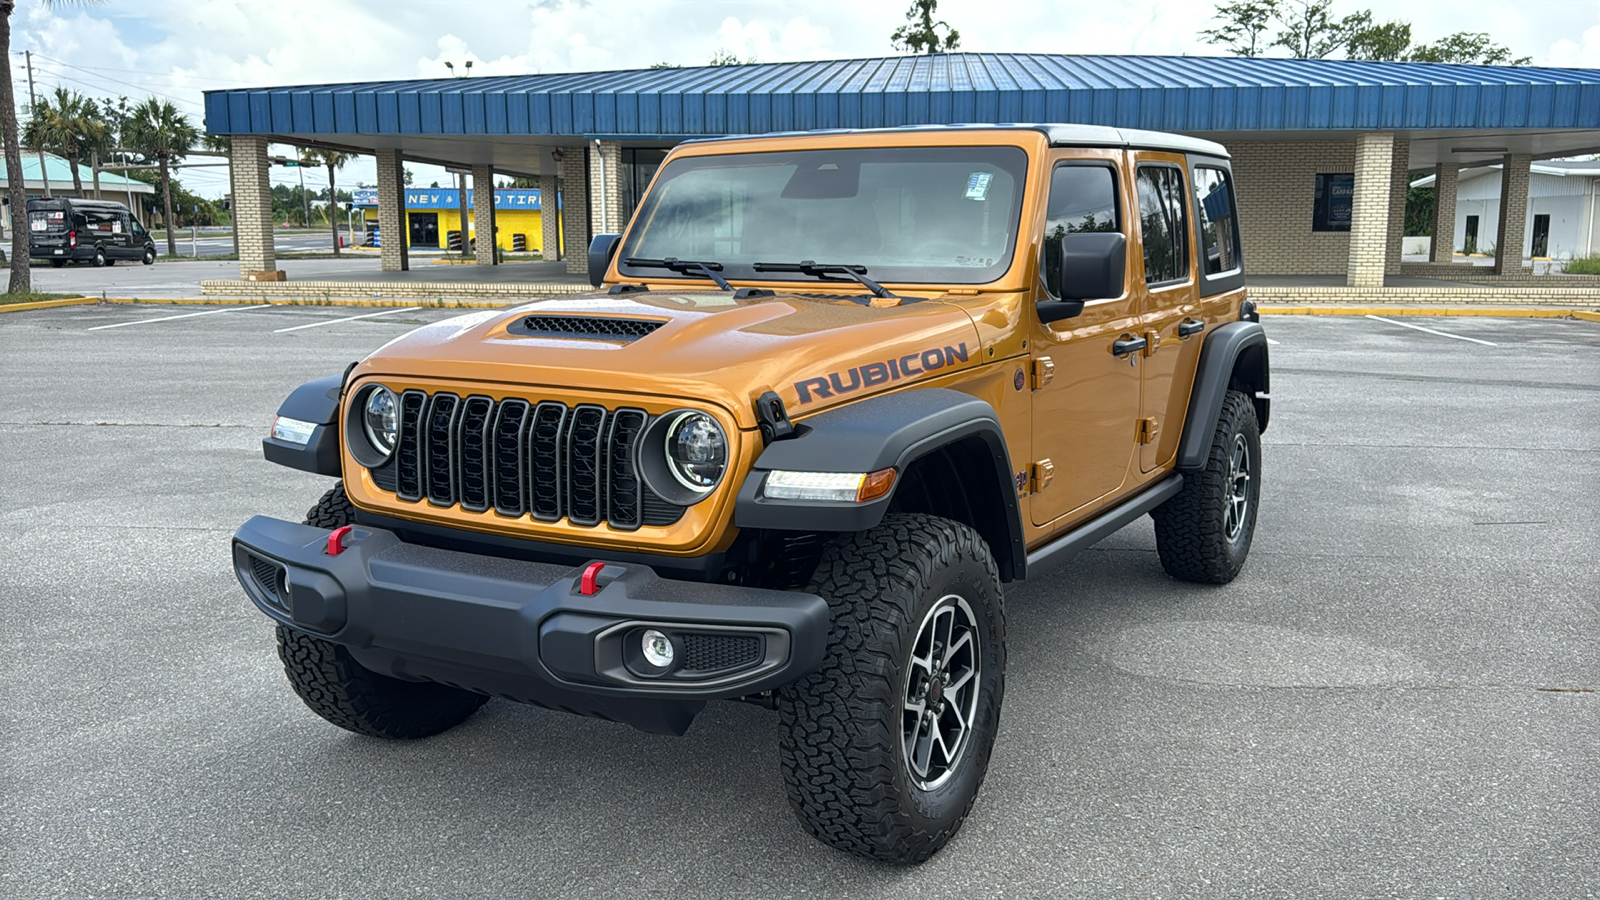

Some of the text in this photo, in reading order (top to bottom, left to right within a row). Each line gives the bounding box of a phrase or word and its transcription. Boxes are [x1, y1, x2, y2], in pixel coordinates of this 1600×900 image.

[408, 195, 439, 204] NEW
[446, 195, 453, 203] &
[793, 342, 969, 405] RUBICON
